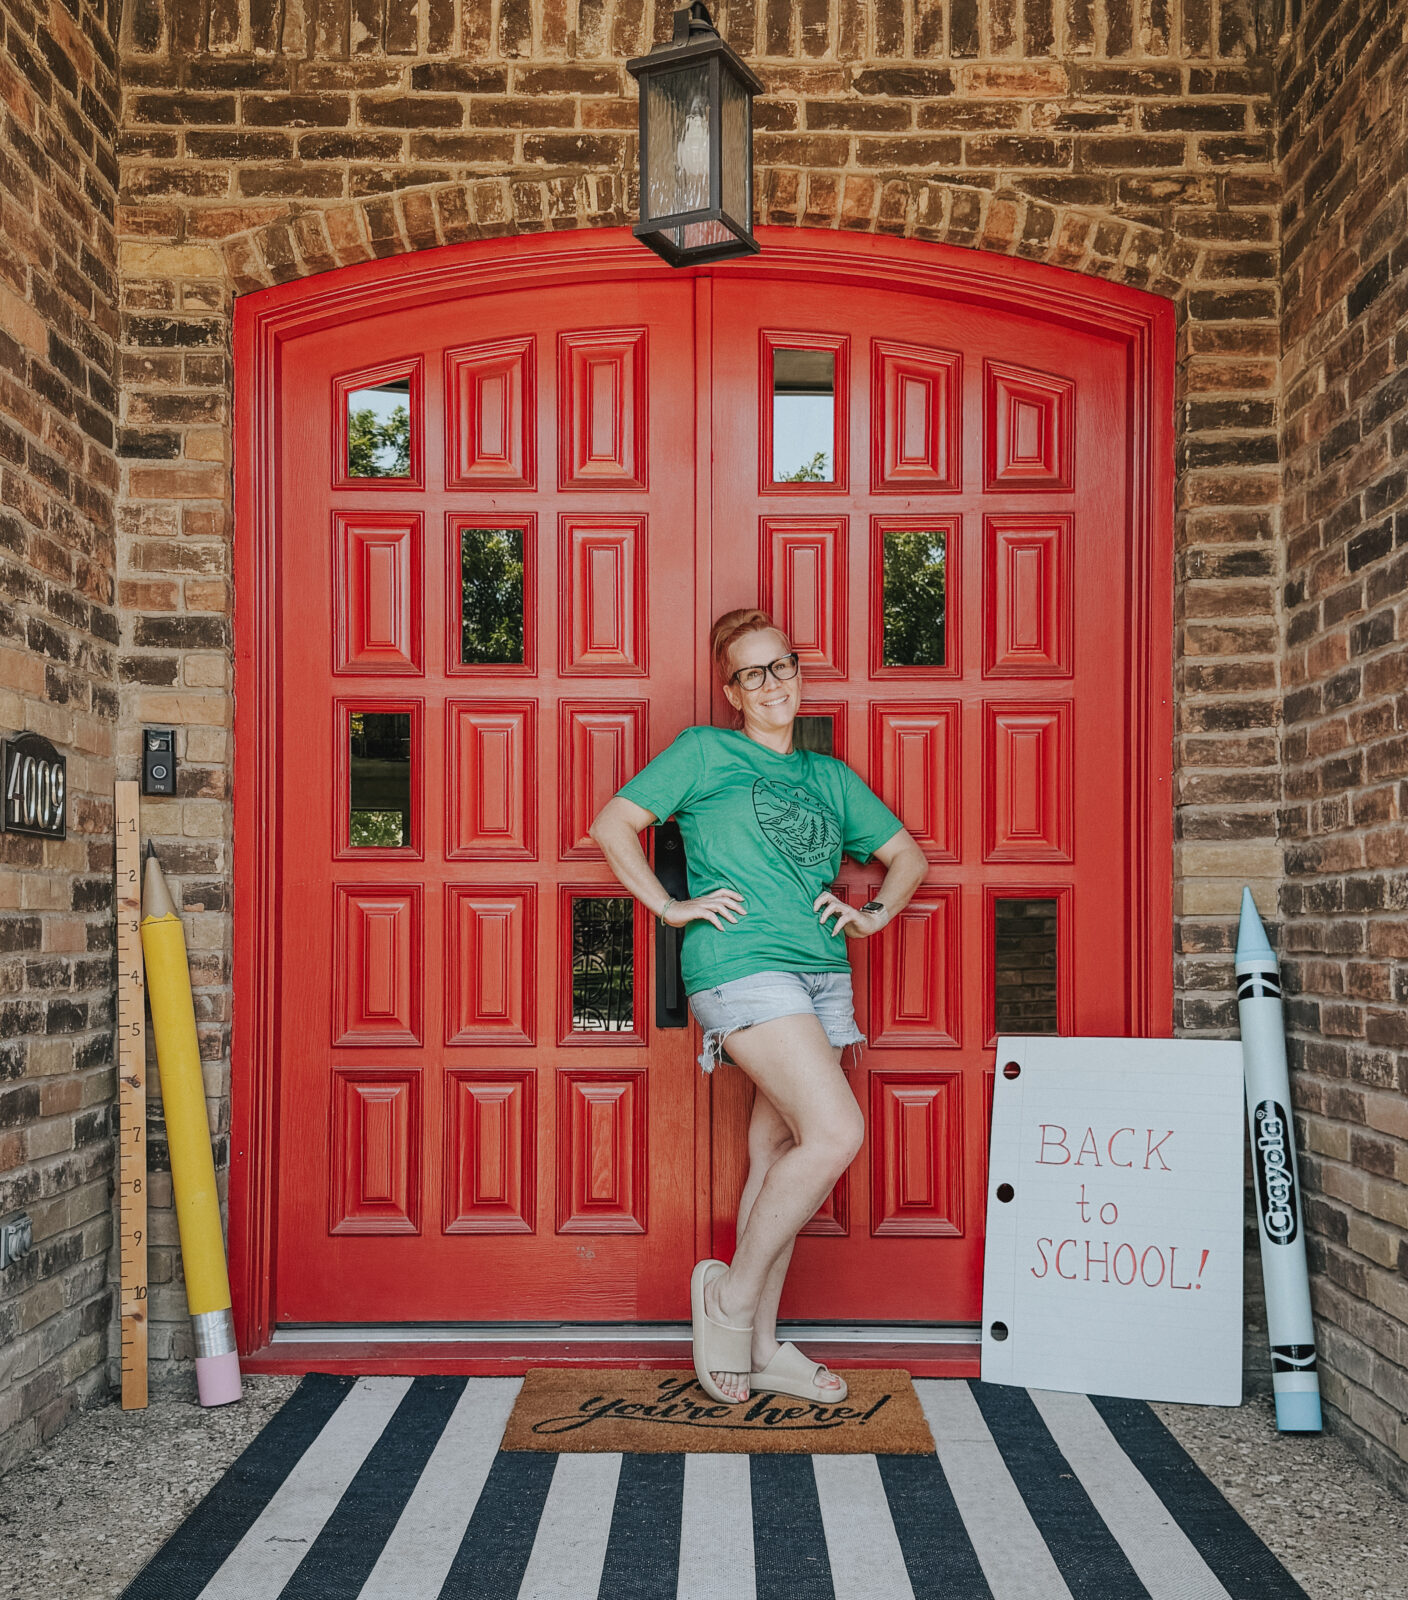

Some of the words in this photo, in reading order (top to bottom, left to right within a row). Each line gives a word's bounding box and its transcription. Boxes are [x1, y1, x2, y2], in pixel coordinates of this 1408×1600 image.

[7, 752, 64, 830] 4009
[129, 818, 137, 832] 1
[773, 835, 784, 846] THE
[808, 852, 825, 863] STATE
[129, 870, 137, 882] 2
[130, 920, 139, 932] 3
[130, 970, 140, 985] 4
[131, 1022, 141, 1036] 5
[132, 1127, 141, 1142] 7
[1035, 1124, 1175, 1171] BACK
[1258, 1116, 1294, 1237] Crayola
[133, 1179, 142, 1193] 8
[1076, 1184, 1119, 1225] to
[133, 1230, 142, 1246] 9
[1030, 1237, 1210, 1290] SCHOOL!
[134, 1287, 147, 1300] 10
[532, 1397, 732, 1434] you're
[744, 1395, 892, 1426] here!
